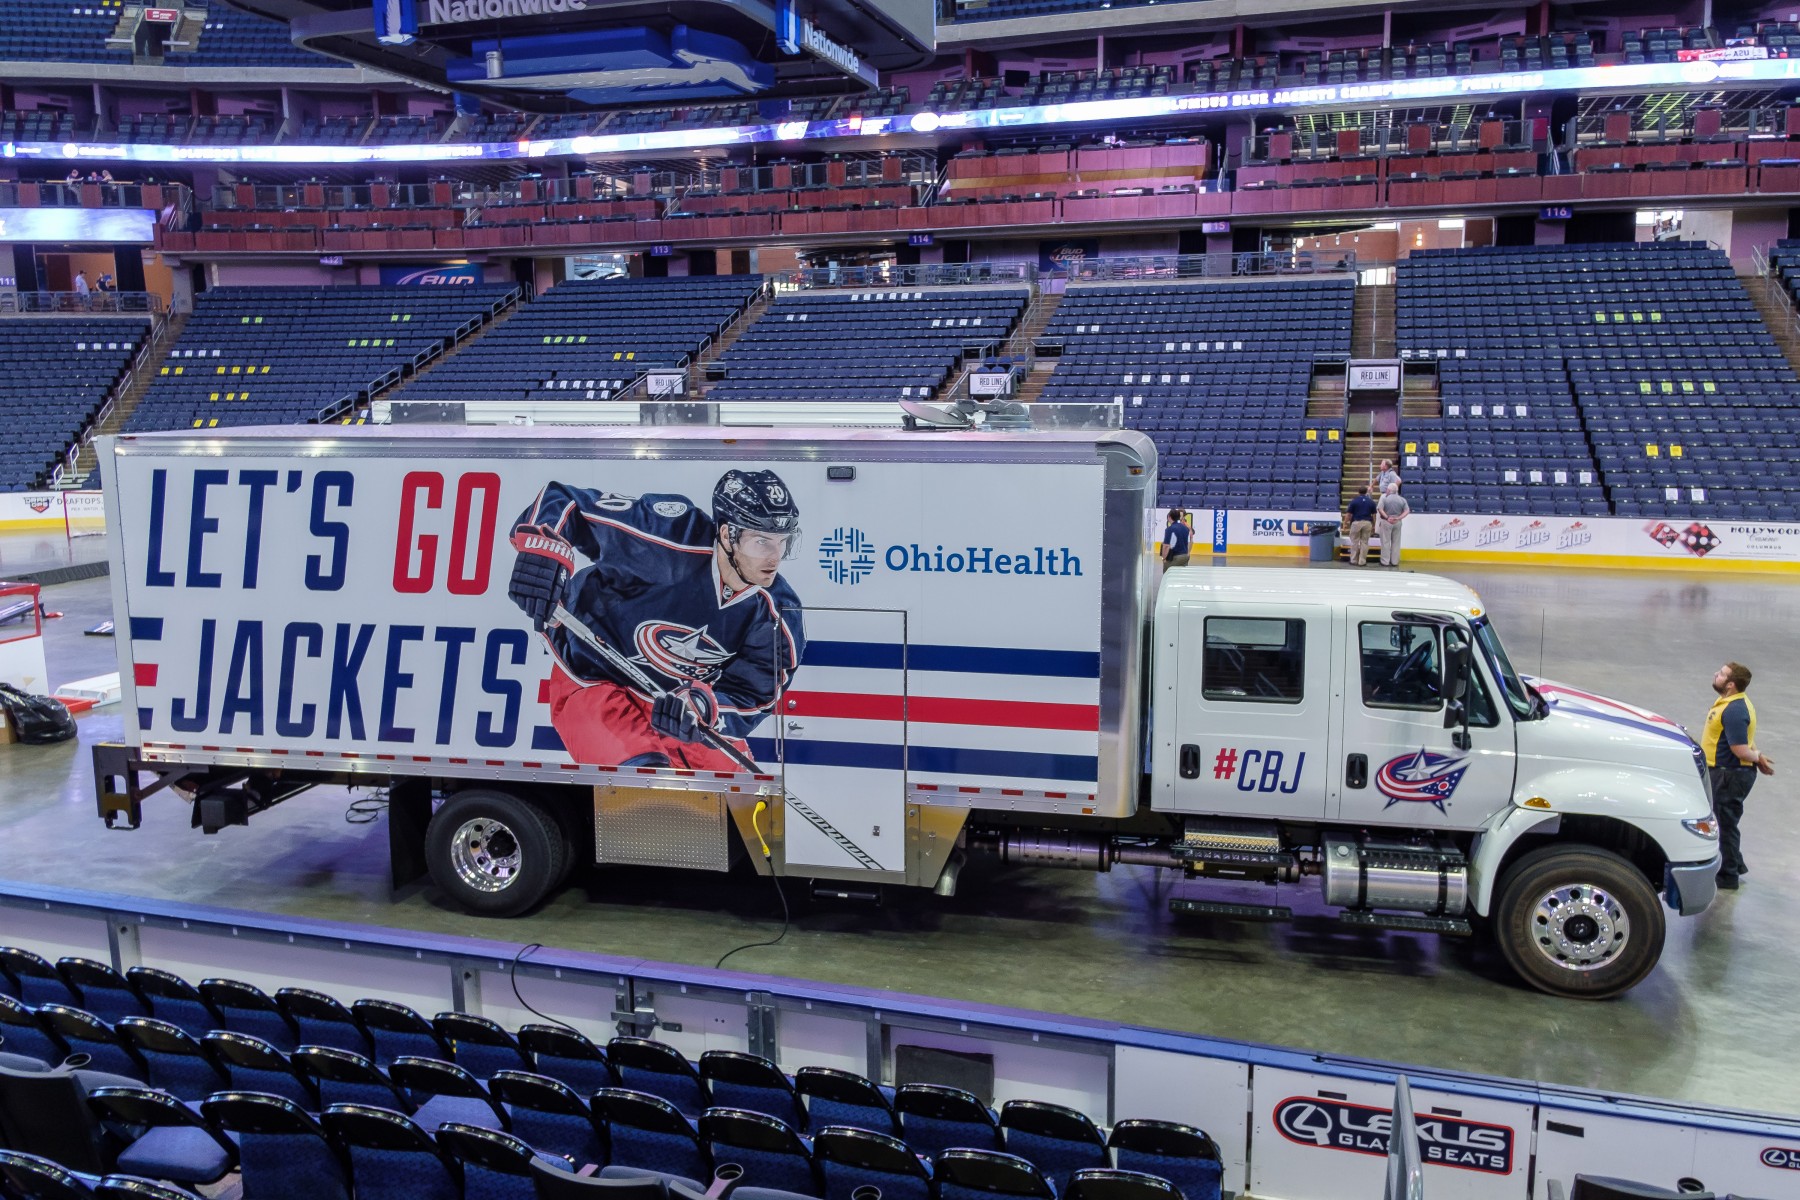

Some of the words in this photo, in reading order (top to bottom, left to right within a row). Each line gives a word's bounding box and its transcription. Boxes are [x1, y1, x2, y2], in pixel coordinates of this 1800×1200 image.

[429, 0, 587, 24] Nationwide
[804, 18, 859, 73] Nationwide
[1546, 207, 1567, 216] 116
[912, 235, 929, 243] 114
[654, 245, 669, 254] 113
[0, 277, 15, 286] 111
[979, 377, 990, 386] RED
[991, 377, 1003, 386] LINE
[1360, 371, 1374, 380] RED
[1375, 371, 1389, 380] LINE
[146, 468, 355, 591] LET'S
[392, 471, 502, 595] GO
[1215, 509, 1225, 546] Reebok
[1253, 518, 1285, 531] FOX
[1730, 526, 1800, 535] HOLLYWOOD
[1436, 529, 1469, 545] Blue
[1476, 530, 1509, 546] Blue
[1516, 531, 1550, 548] Blue
[1557, 532, 1592, 549] Blue
[885, 544, 1083, 576] OhioHealth
[171, 618, 529, 748] JACKETS
[1213, 747, 1306, 794] #CBJ
[1338, 1132, 1389, 1151] GLA
[1428, 1147, 1505, 1168] SEATS
